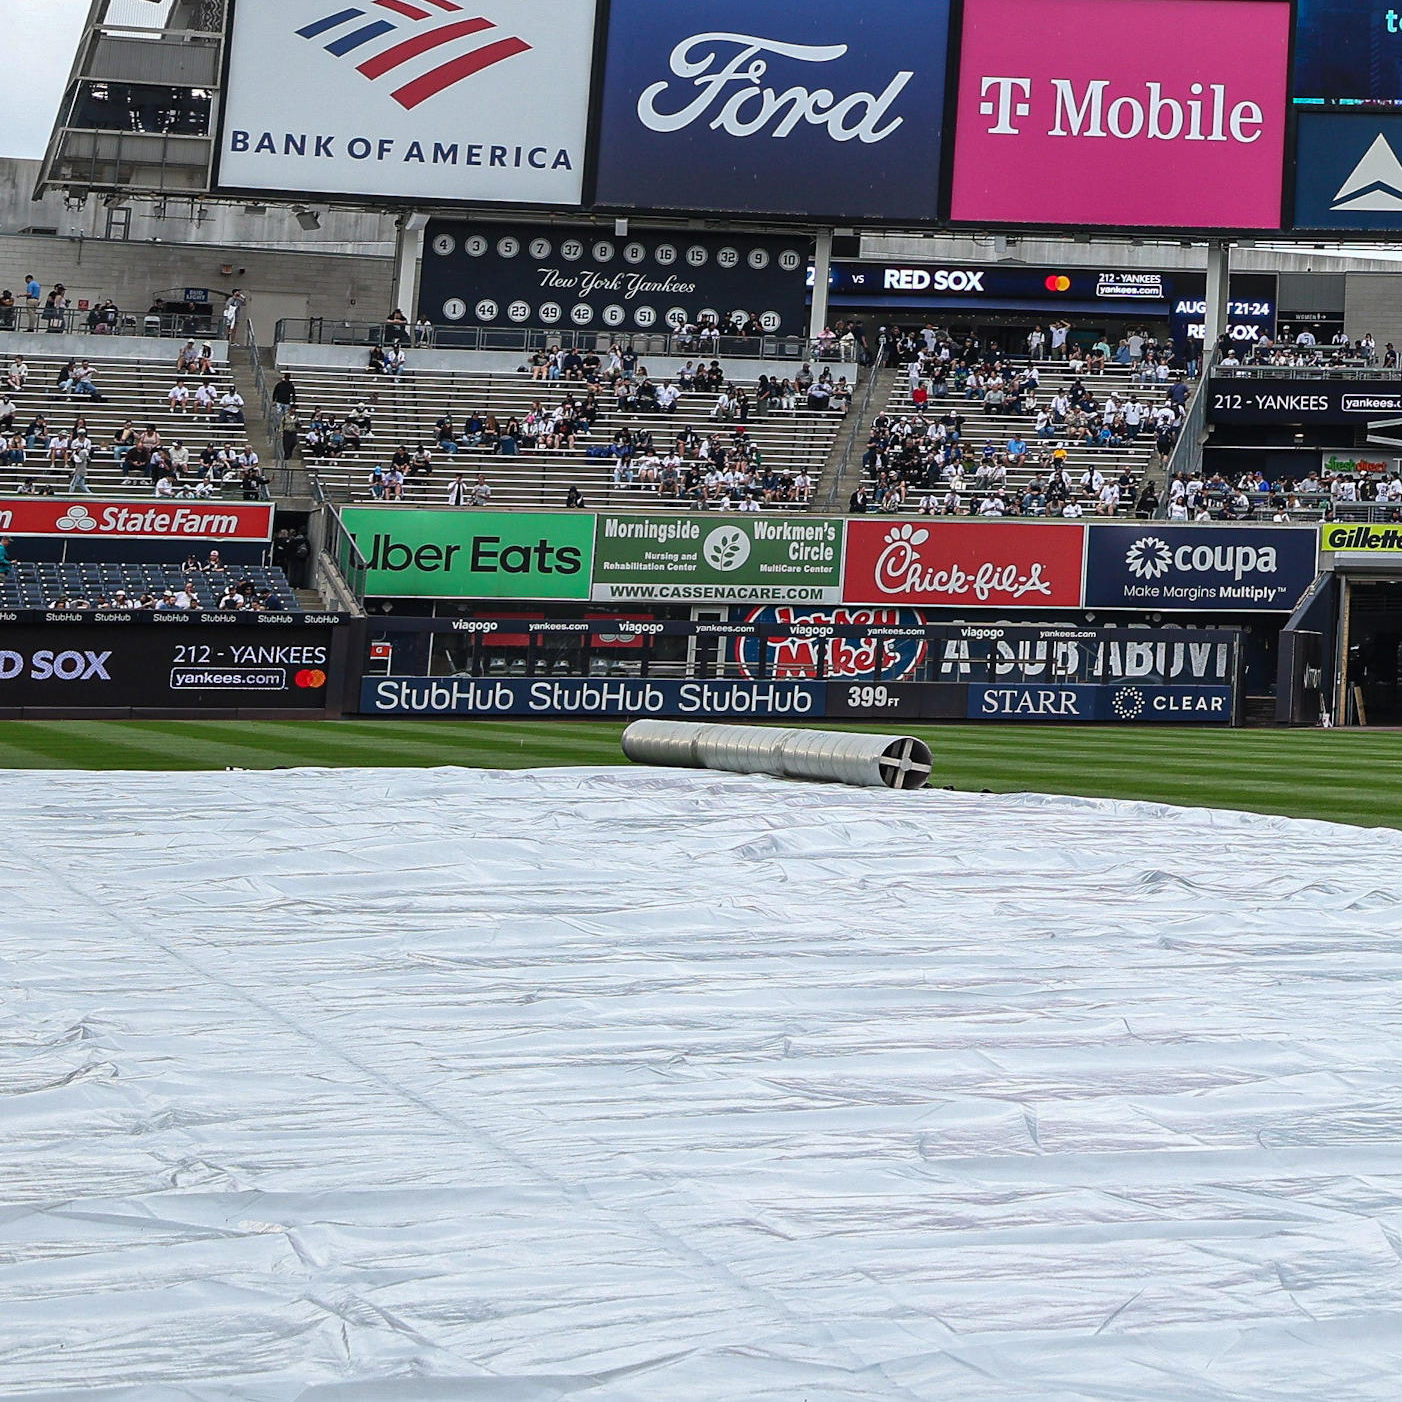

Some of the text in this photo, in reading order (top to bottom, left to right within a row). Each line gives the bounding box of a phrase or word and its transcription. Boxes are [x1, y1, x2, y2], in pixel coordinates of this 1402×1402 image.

[637, 31, 914, 144] Ford
[1047, 79, 1264, 144] Mobile
[231, 130, 574, 171] BANK OF AMERICA
[564, 244, 579, 256] 37
[660, 249, 672, 260] 16
[720, 252, 735, 263] 32
[783, 254, 796, 265] 10
[537, 268, 696, 300] New York Yankees
[884, 269, 984, 291] RED SOX
[1120, 274, 1161, 284] YANKEES
[1100, 286, 1159, 296] yankees.com
[478, 305, 776, 327] 44 42 51 21
[1214, 394, 1328, 410] 212 YANKEES
[605, 518, 836, 543] Morningside Workmen's
[350, 533, 582, 575] Uber Eats
[645, 551, 697, 562] Nursing and
[788, 541, 833, 561] Circle
[603, 562, 697, 572] Rehabilitation Center
[760, 564, 833, 574] MultiCare Center
[874, 530, 1052, 599] Chick-fil-A
[1173, 544, 1278, 580] coupa
[610, 586, 824, 600] WWW.CASSENACARE.COM
[1124, 585, 1159, 599] Make
[1162, 585, 1216, 601] Margins
[46, 612, 340, 624] StubHub StubHub
[452, 619, 833, 636] viagogo yankees.com viagogo
[175, 669, 284, 687] yankees.com
[375, 681, 663, 713] StubHub StubHub
[847, 685, 900, 707] 399 FT
[982, 689, 1079, 715] STARR
[1153, 695, 1223, 711] CLEAR
